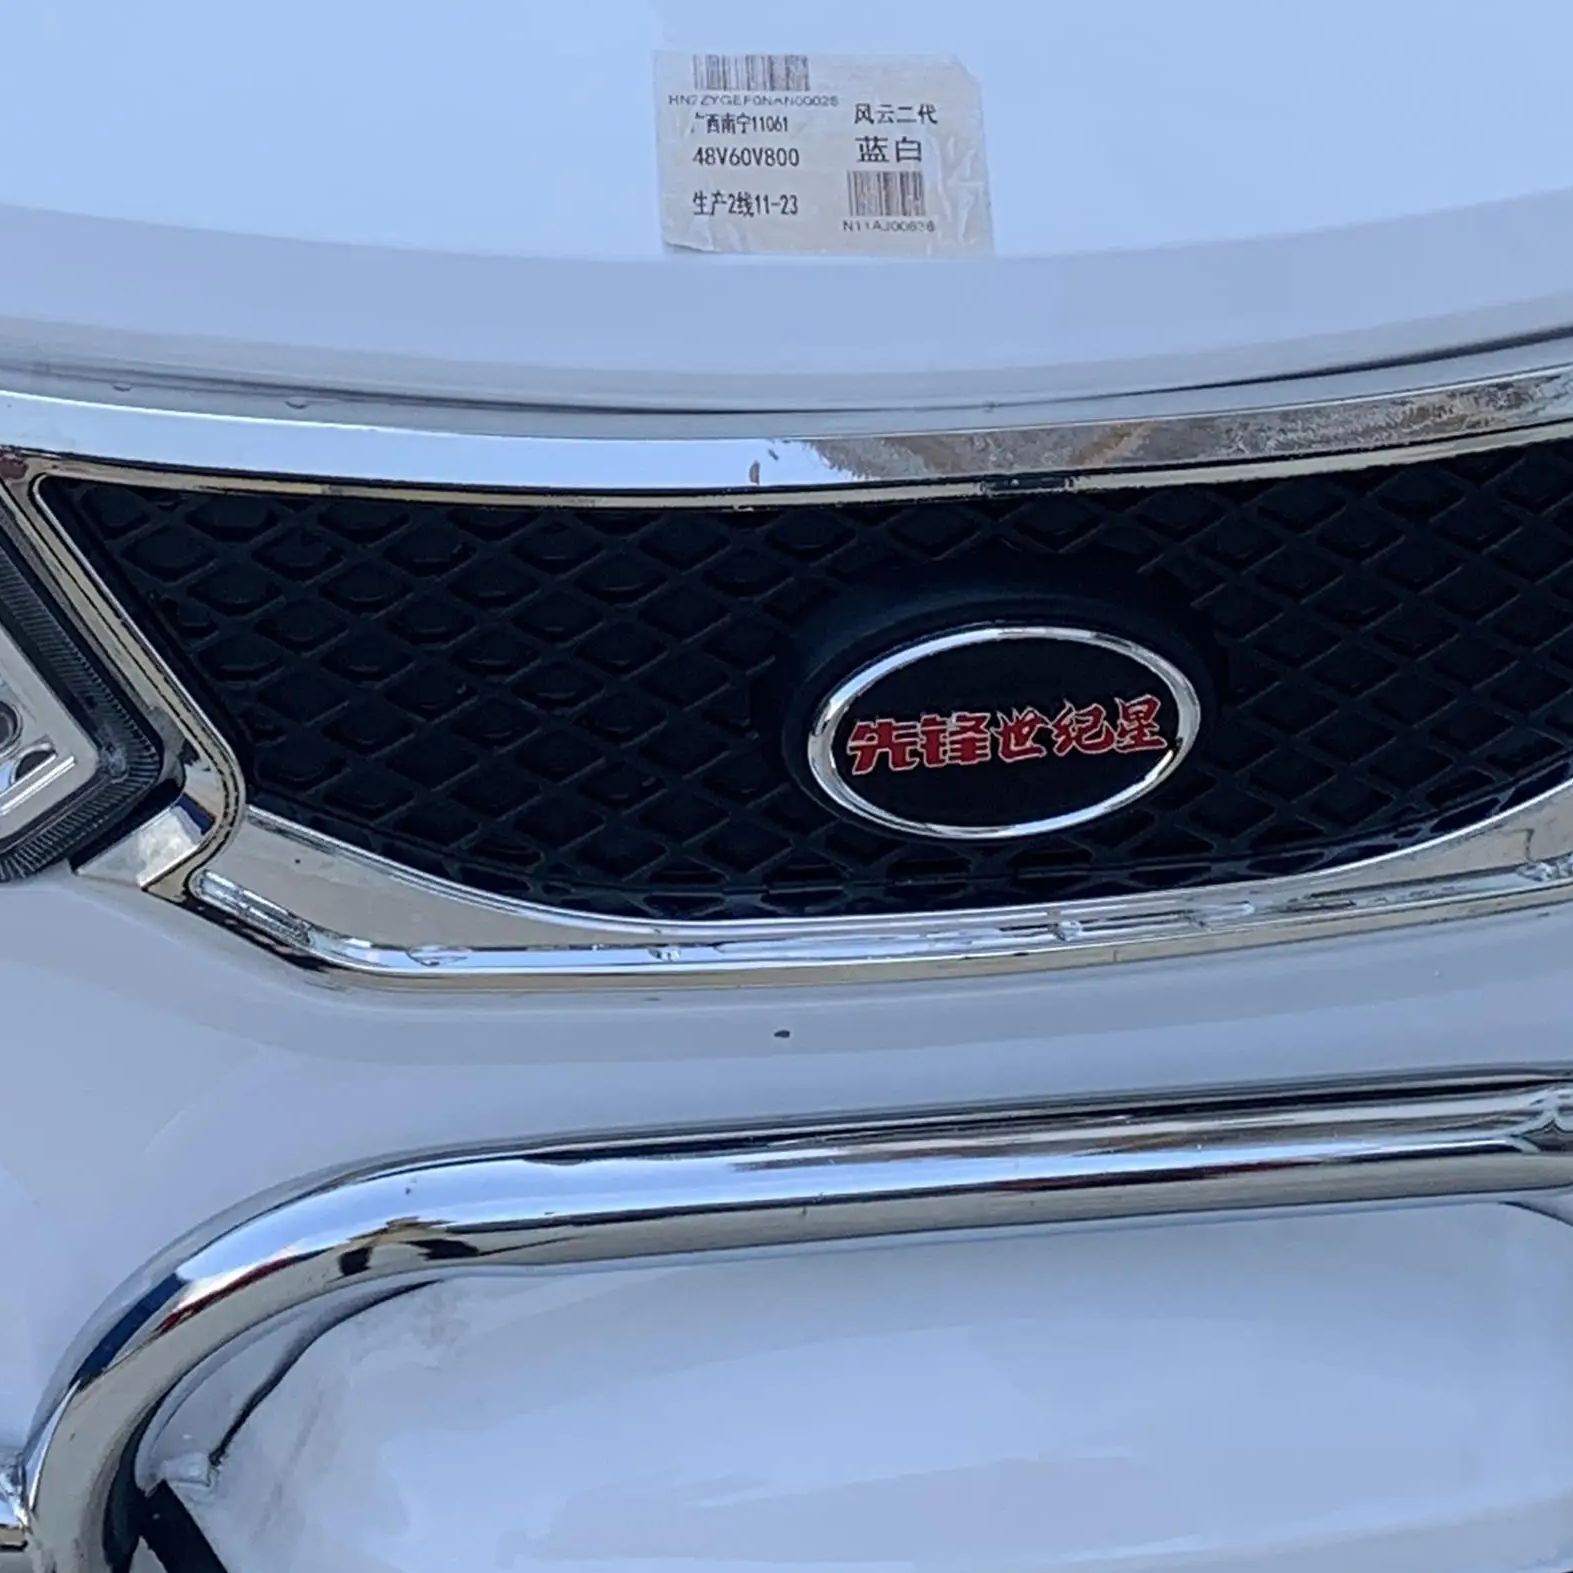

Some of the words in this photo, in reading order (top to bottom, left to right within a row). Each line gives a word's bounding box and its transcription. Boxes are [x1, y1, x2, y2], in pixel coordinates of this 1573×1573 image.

[854, 103, 938, 126] 风云二代
[692, 146, 800, 168] 48V60V800
[856, 135, 923, 164] 蓝白
[692, 190, 799, 218] 生产2线11-23
[846, 693, 1168, 776] 先锋世纪星
